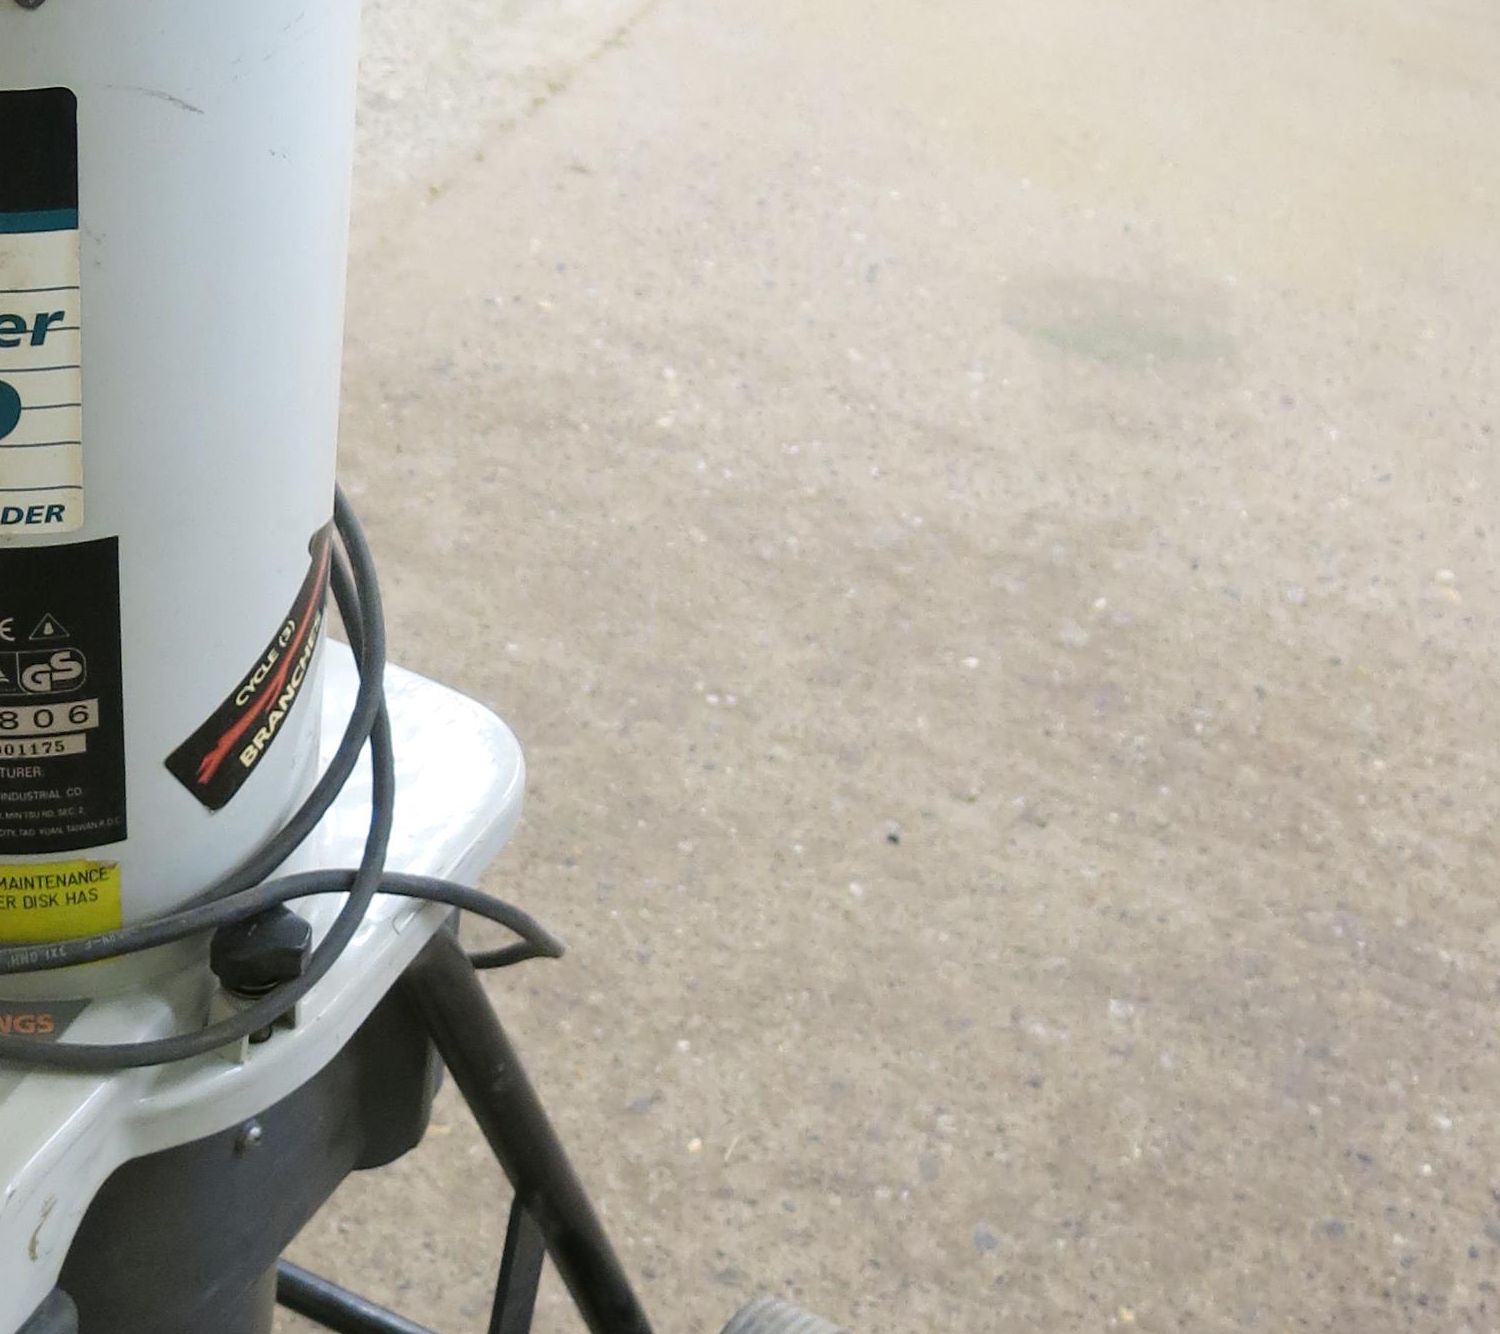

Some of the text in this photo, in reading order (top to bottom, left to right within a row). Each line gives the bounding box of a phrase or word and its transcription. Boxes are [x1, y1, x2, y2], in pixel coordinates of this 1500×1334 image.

[235, 619, 296, 706] CYCLE (3)
[0, 787, 62, 801] INDUSTRIAL
[23, 892, 60, 909] DISK
[66, 888, 99, 906] HAS
